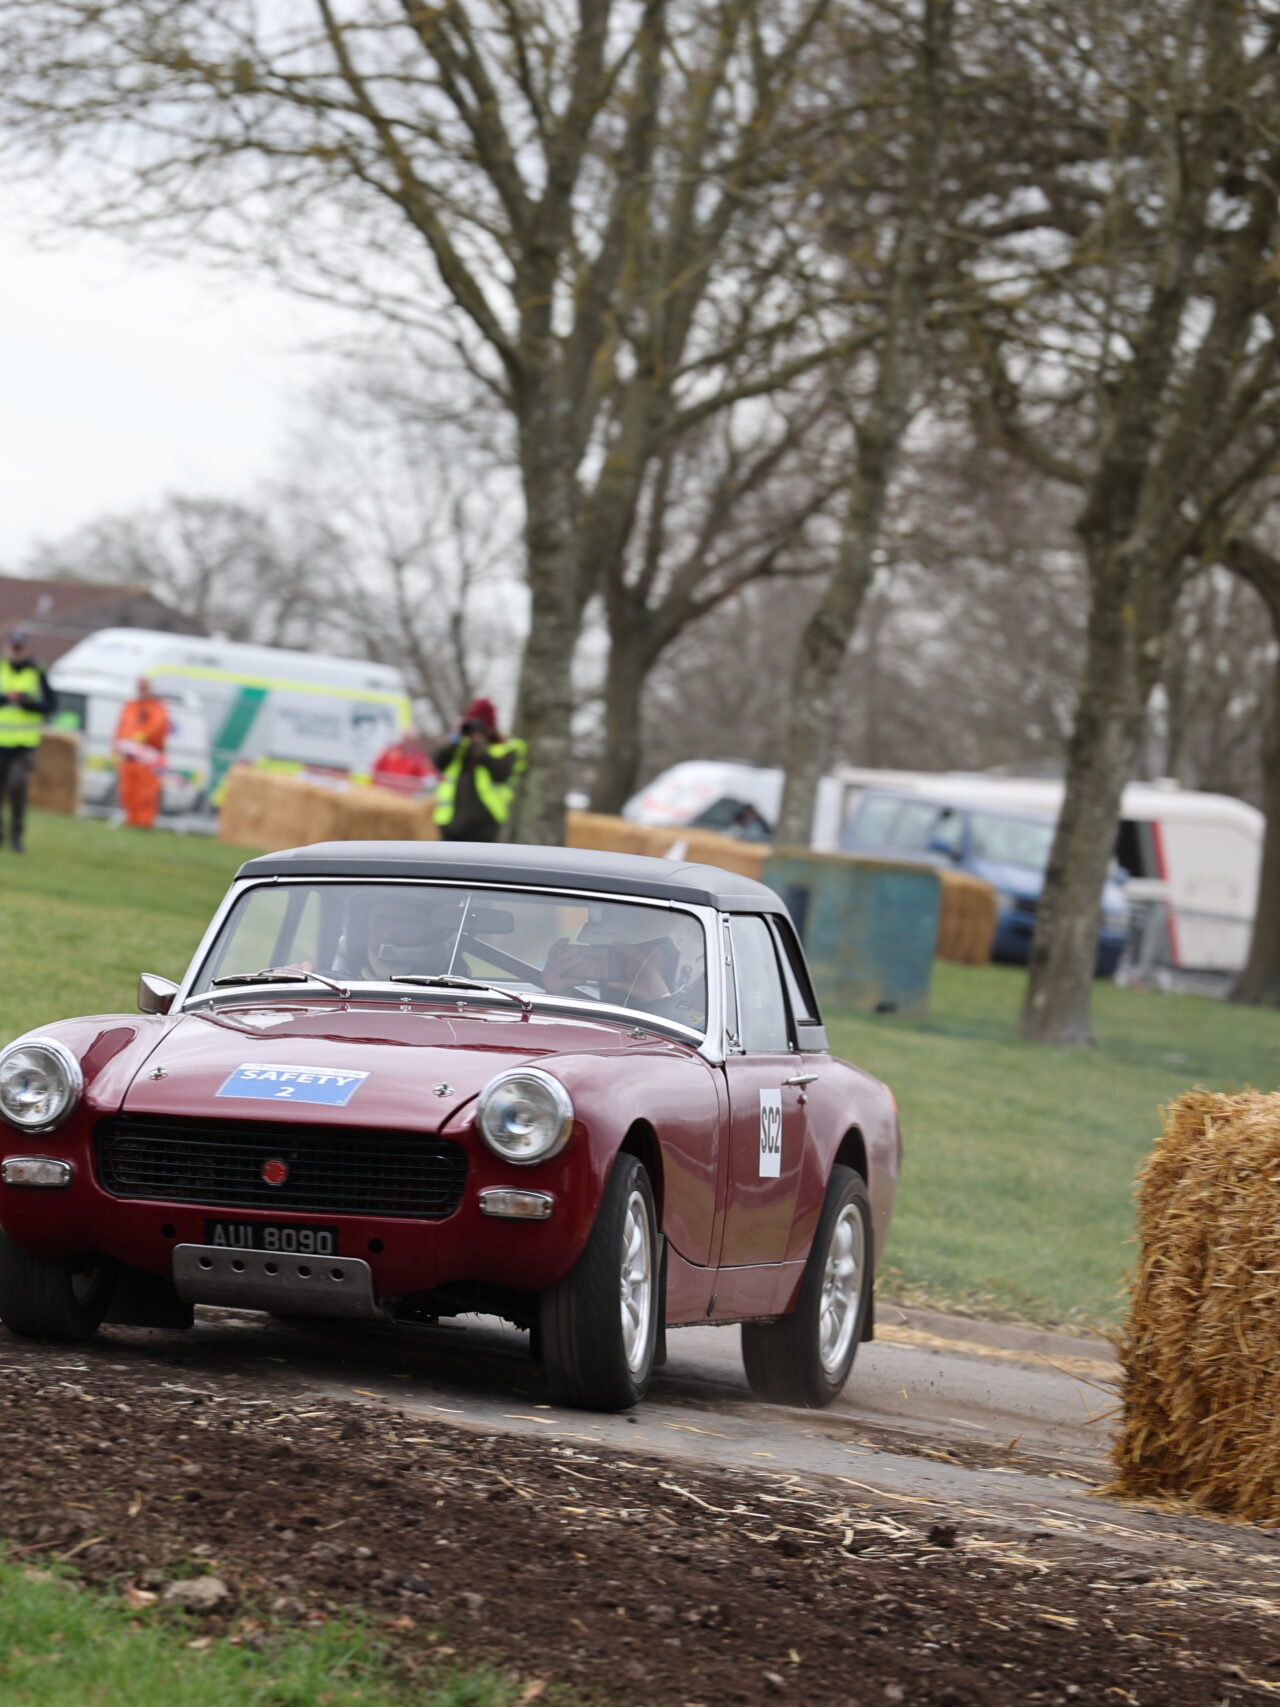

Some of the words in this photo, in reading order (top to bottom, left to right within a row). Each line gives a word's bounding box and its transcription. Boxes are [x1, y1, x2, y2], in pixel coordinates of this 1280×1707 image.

[239, 1069, 355, 1086] SAFETY
[274, 1086, 296, 1097] 2
[761, 1106, 781, 1154] SC2
[214, 1224, 253, 1248] AUI
[263, 1227, 333, 1255] 8090
